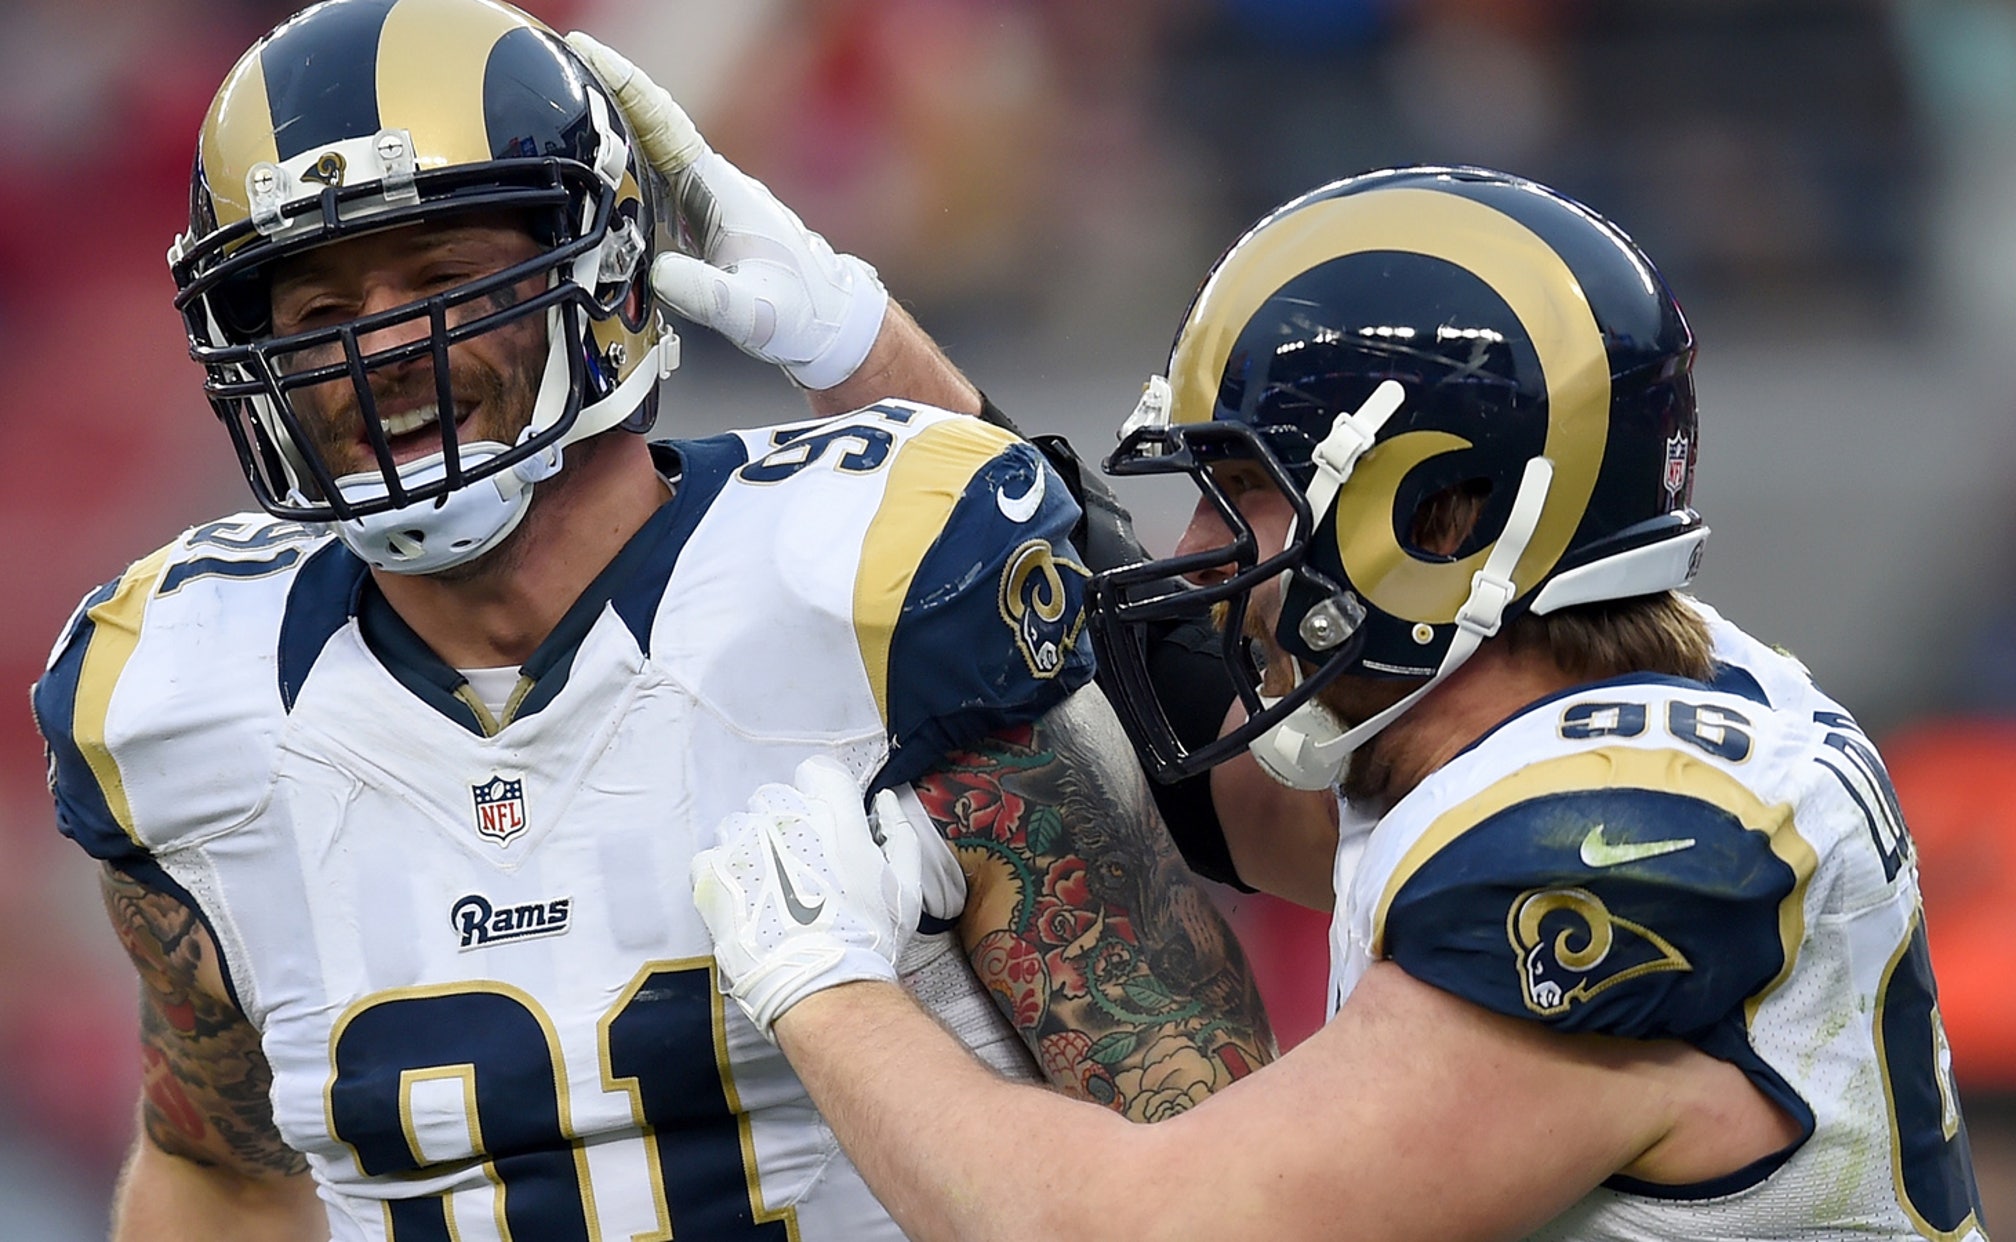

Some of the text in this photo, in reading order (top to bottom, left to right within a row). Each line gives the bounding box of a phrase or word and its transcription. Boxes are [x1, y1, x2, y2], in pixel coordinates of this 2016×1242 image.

[1556, 699, 1755, 765] 96
[480, 801, 521, 833] NFL
[451, 894, 570, 948] Rams
[324, 955, 801, 1242] 91
